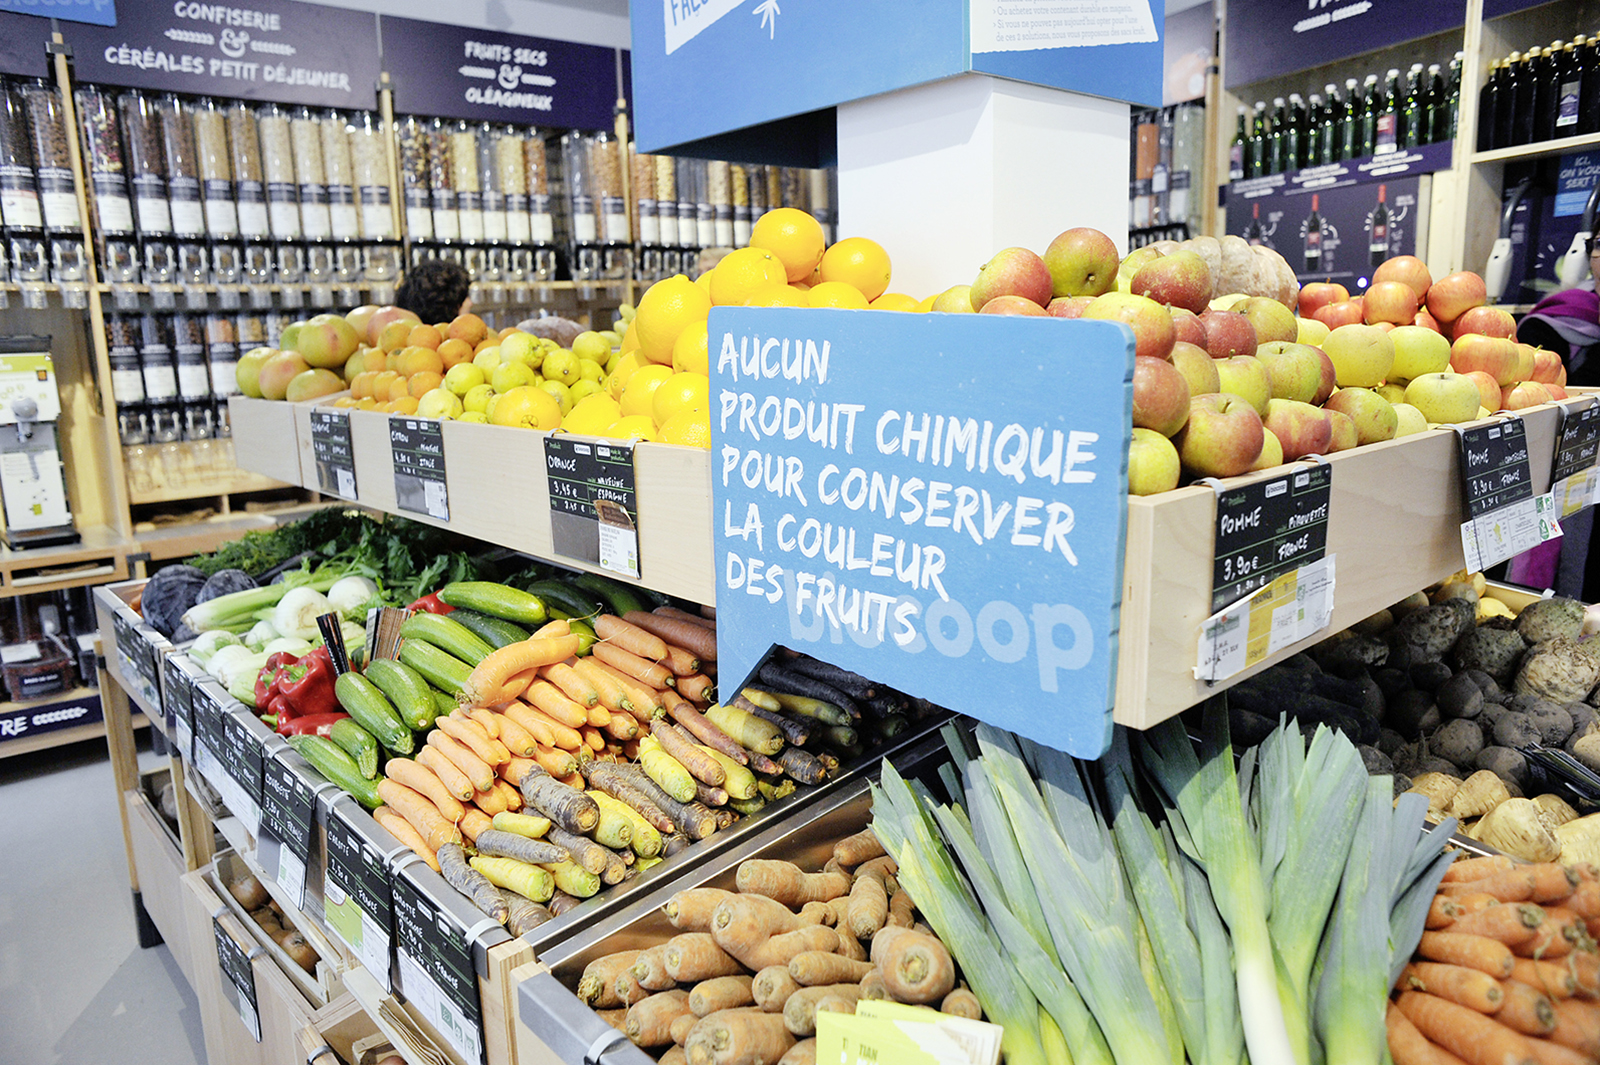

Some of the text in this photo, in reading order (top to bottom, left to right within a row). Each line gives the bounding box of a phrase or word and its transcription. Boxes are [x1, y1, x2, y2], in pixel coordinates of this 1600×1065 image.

[174, 1, 281, 31] CONFISERIE
[220, 28, 249, 57] &
[464, 41, 548, 66] FRUITS SECS
[105, 43, 351, 92] CÉRÉALES PETIT DÉJEUNER
[498, 64, 522, 90] &
[1560, 168, 1576, 179] ON
[717, 332, 831, 384] AUCUN
[719, 389, 1099, 486] PRODUIT CHIMIQUE
[548, 455, 576, 472] ORANGE
[1468, 448, 1489, 467] POMME
[597, 488, 627, 503] ESPAGNE
[721, 444, 1078, 567] POUR CONSERVER
[1221, 506, 1262, 536] POMME
[723, 499, 949, 602] LA COULEUR
[1278, 534, 1309, 560] FRANCE
[726, 551, 920, 646] DES FRUITS
[783, 568, 1095, 693] biocoop
[0, 716, 28, 736] RE
[328, 831, 349, 856] CAROTTE
[358, 889, 378, 915] FRANCE
[393, 889, 416, 918] CAROTTE
[435, 961, 458, 989] FRANCE
[859, 1044, 878, 1061] TIAN
